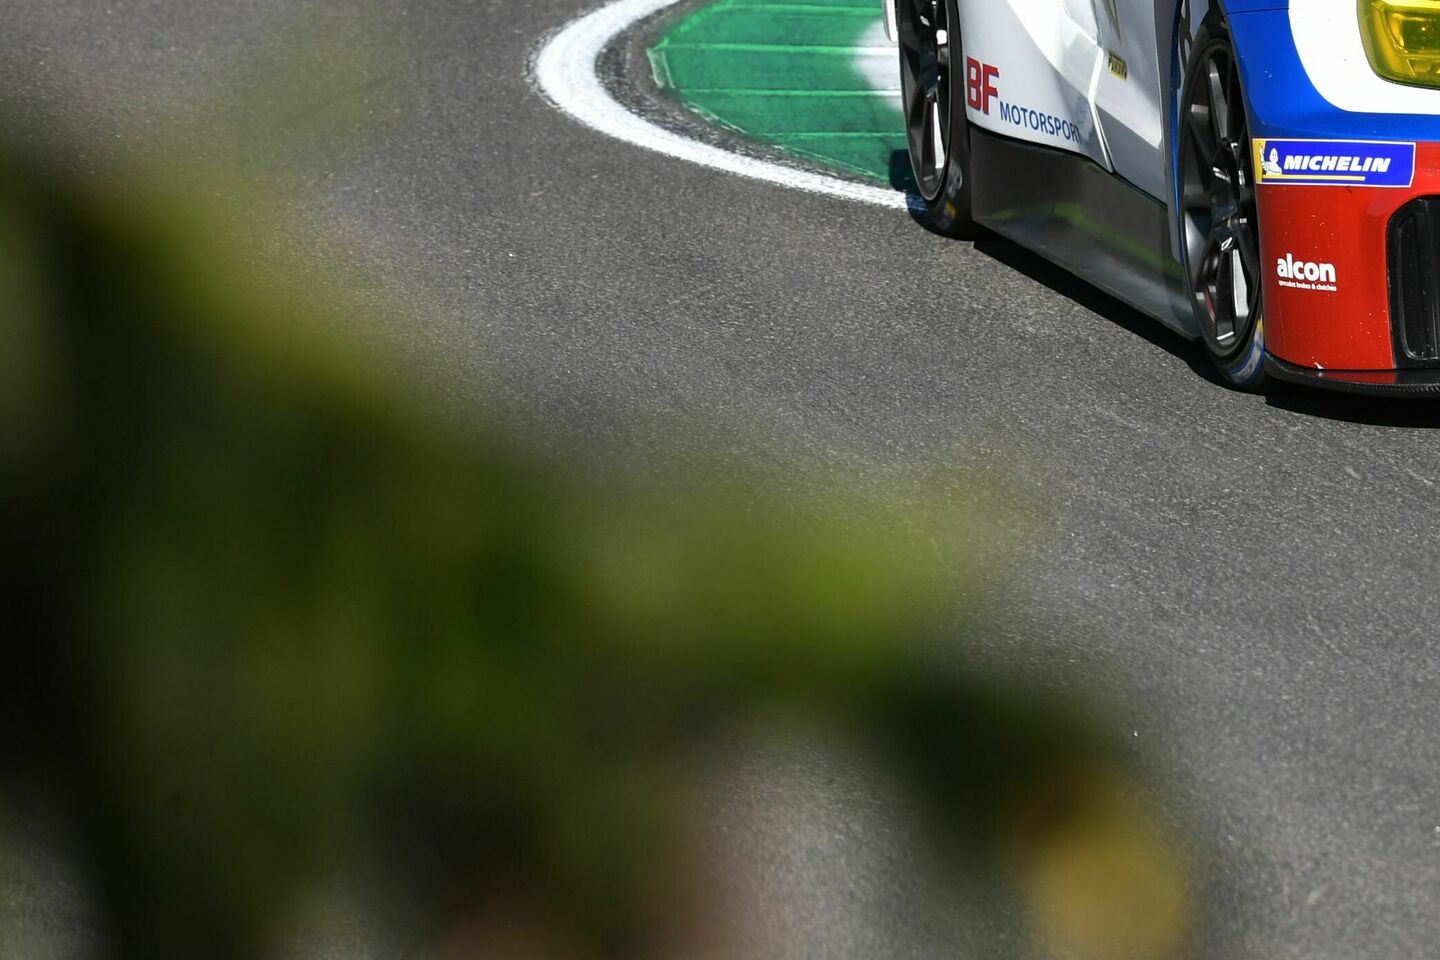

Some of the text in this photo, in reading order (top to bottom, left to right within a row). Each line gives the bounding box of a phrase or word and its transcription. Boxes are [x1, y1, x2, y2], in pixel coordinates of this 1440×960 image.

[966, 55, 1000, 116] BF
[1283, 155, 1392, 173] MICHELIN
[1277, 252, 1337, 283] alcon
